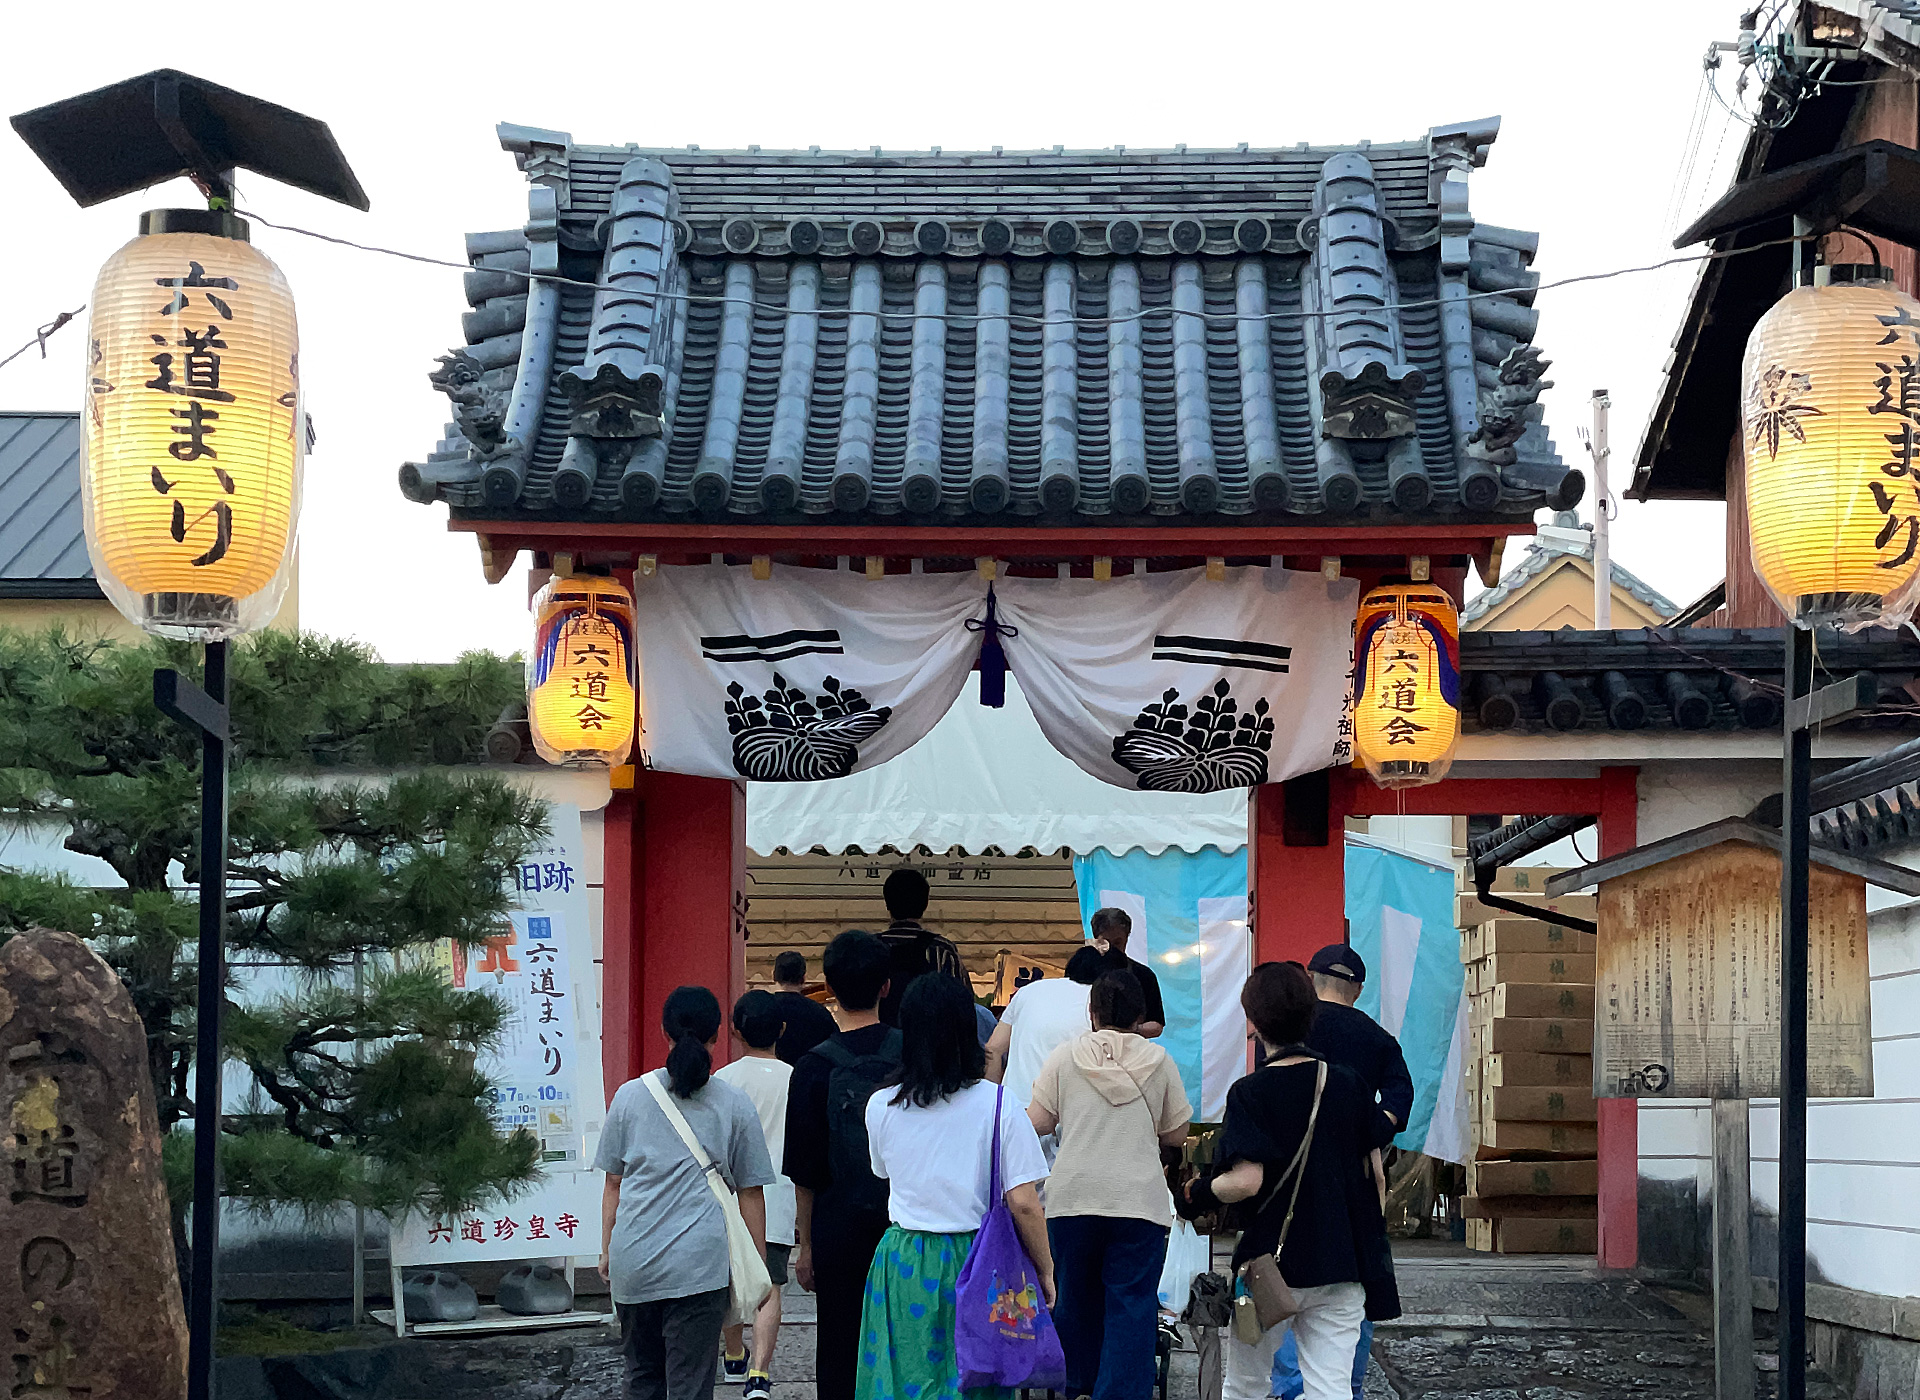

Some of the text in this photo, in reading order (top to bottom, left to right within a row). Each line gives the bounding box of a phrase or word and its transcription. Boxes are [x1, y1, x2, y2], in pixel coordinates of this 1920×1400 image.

[145, 260, 239, 567] 六道まいり
[570, 643, 615, 731] 六道会
[1378, 649, 1431, 745] 六道会
[525, 942, 565, 1076] 六道まいり
[427, 1212, 580, 1244] 六道珍皇寺
